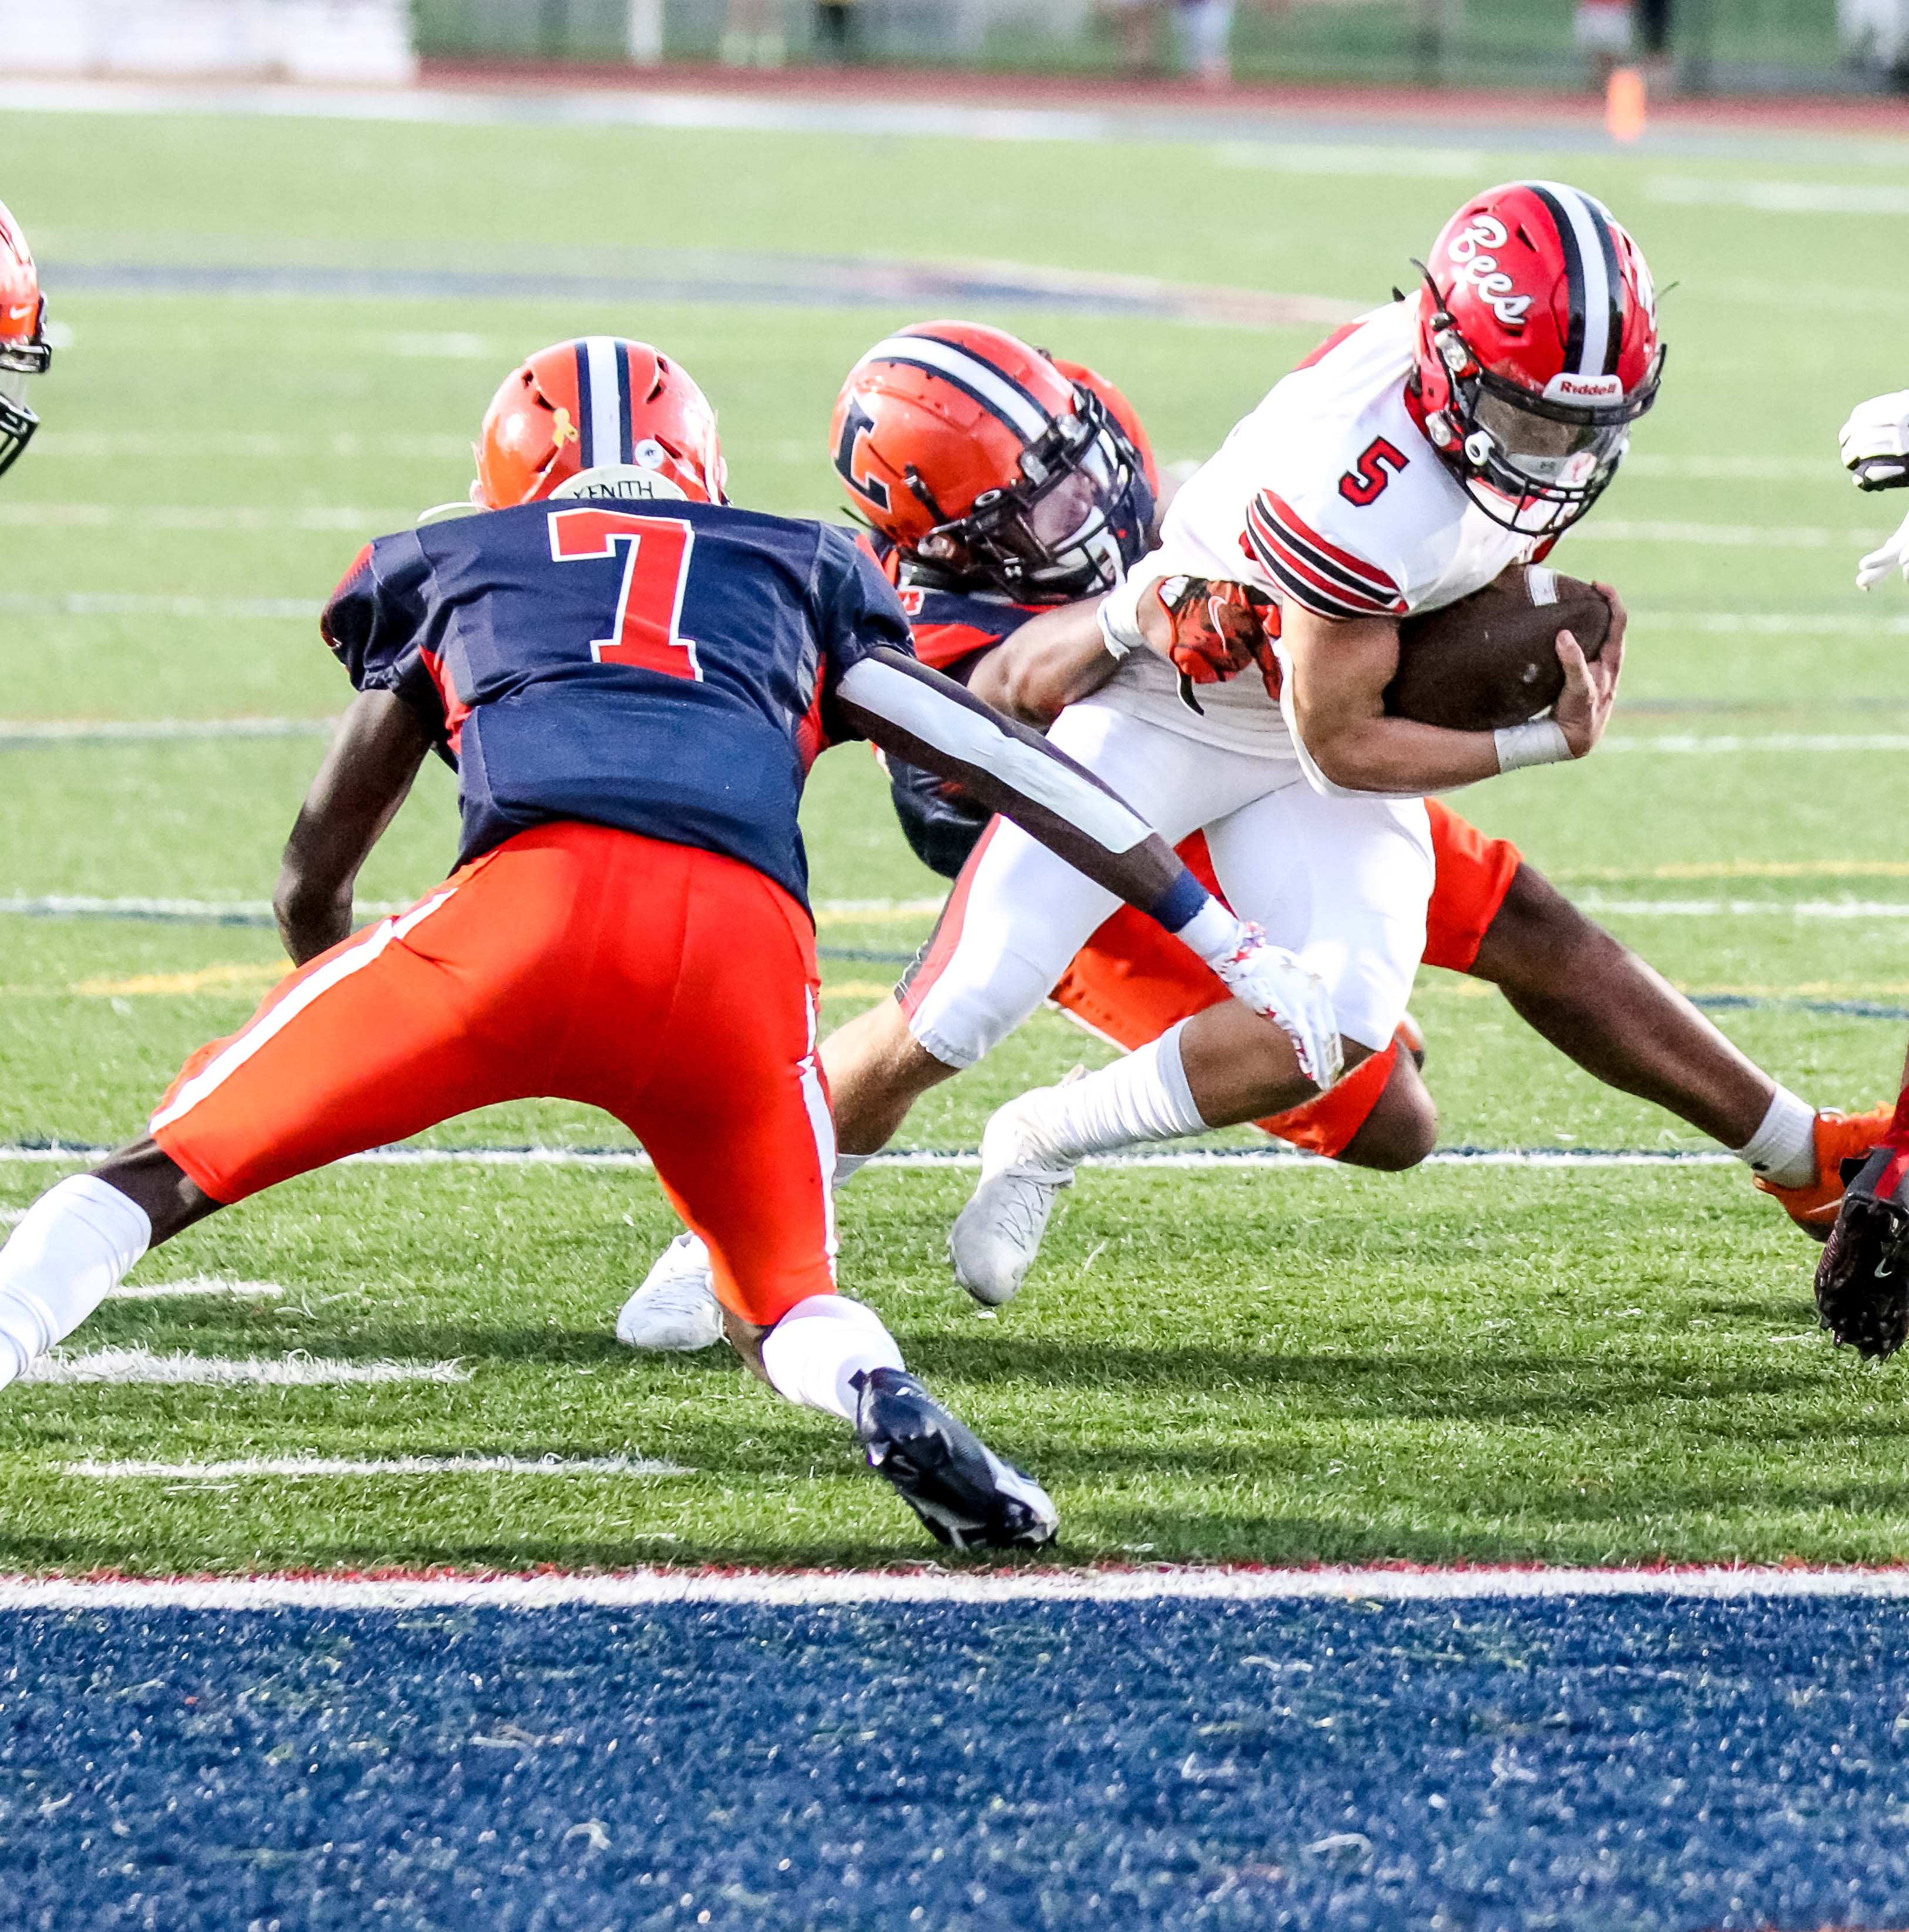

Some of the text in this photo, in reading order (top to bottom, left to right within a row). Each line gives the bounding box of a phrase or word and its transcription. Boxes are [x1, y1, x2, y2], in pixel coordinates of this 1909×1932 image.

[1447, 214, 1533, 324] Bees
[1561, 381, 1616, 395] Riddell
[1338, 435, 1410, 507] 5
[548, 507, 703, 682] 7
